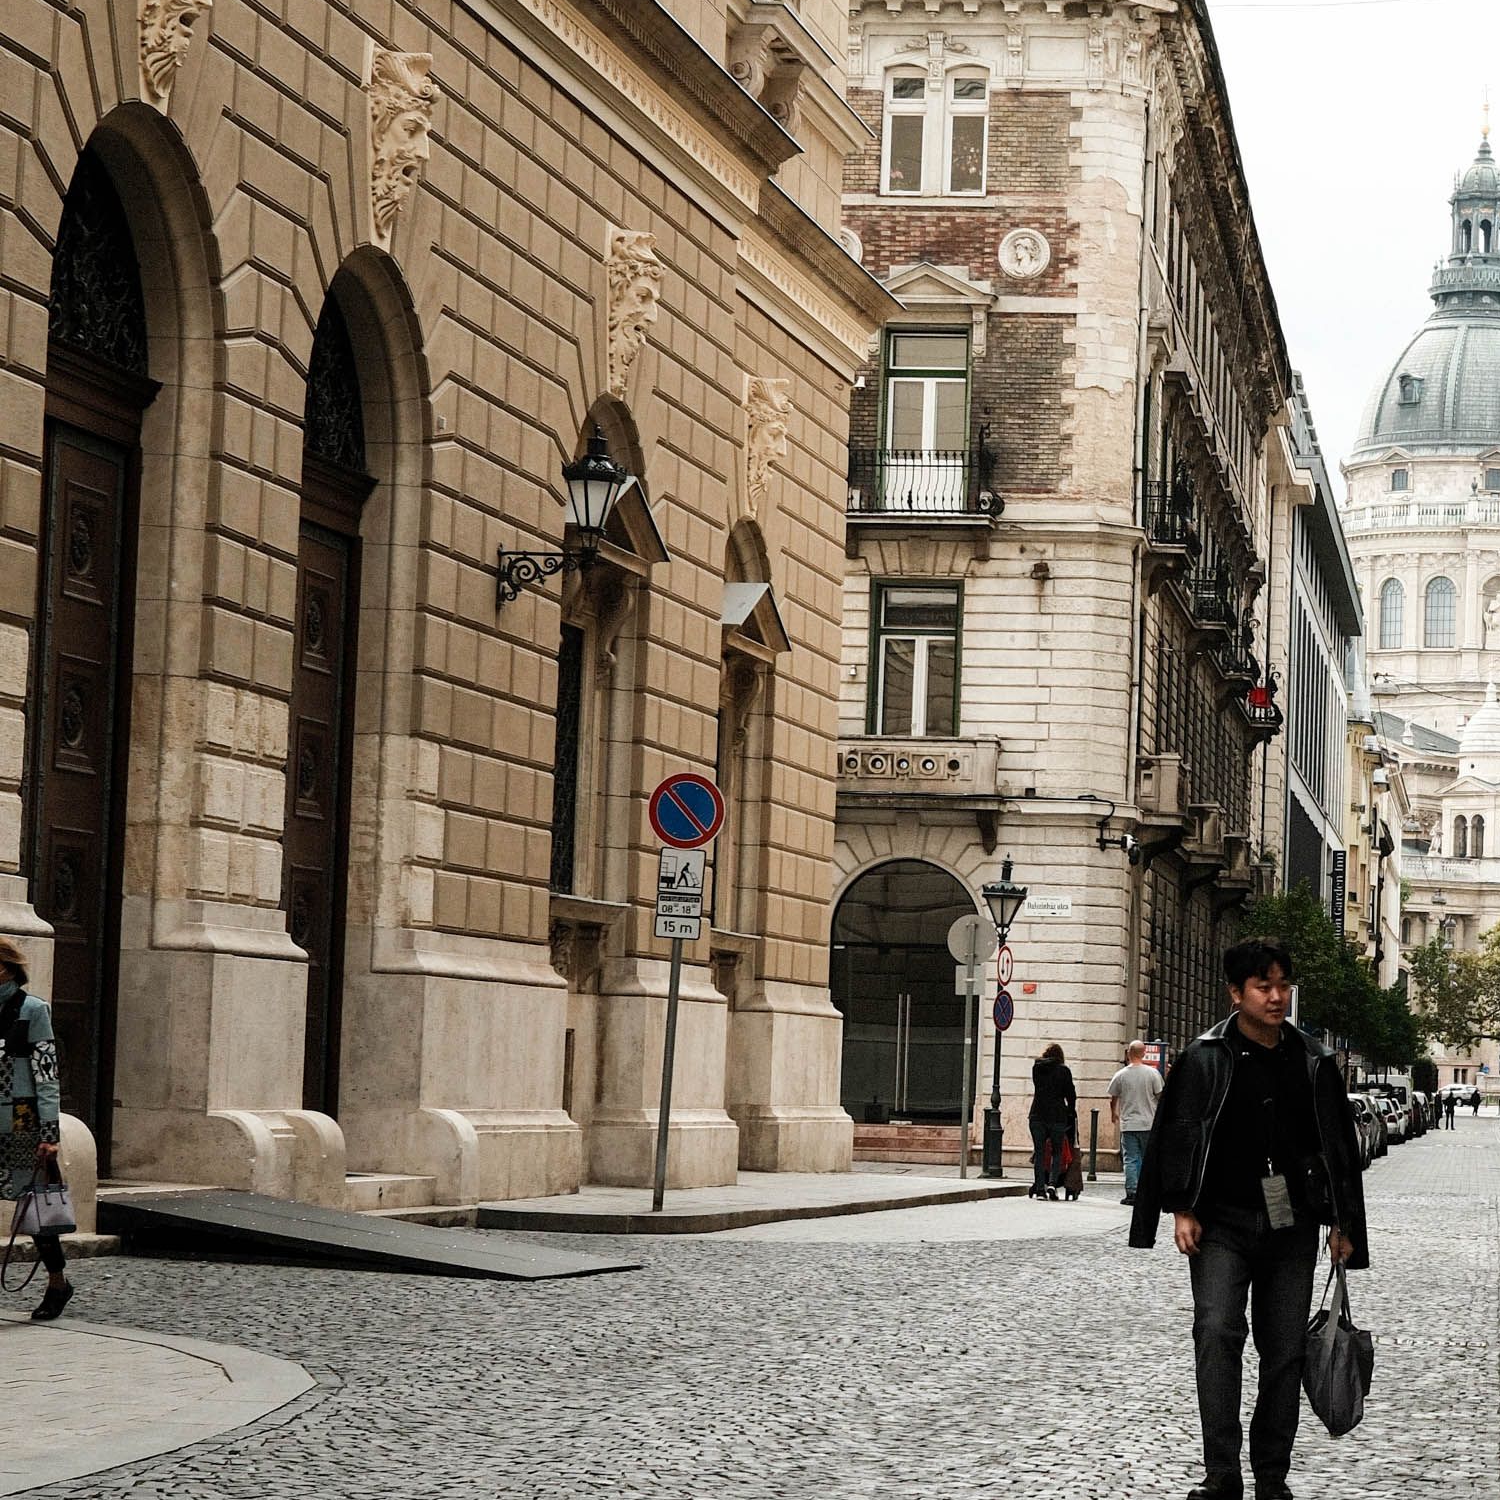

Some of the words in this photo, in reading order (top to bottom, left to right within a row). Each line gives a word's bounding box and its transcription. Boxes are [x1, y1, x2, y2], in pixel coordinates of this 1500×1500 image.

[1335, 852, 1344, 871] Inn
[1334, 876, 1343, 915] Garden
[663, 920, 676, 932] 15
[680, 924, 692, 933] m
